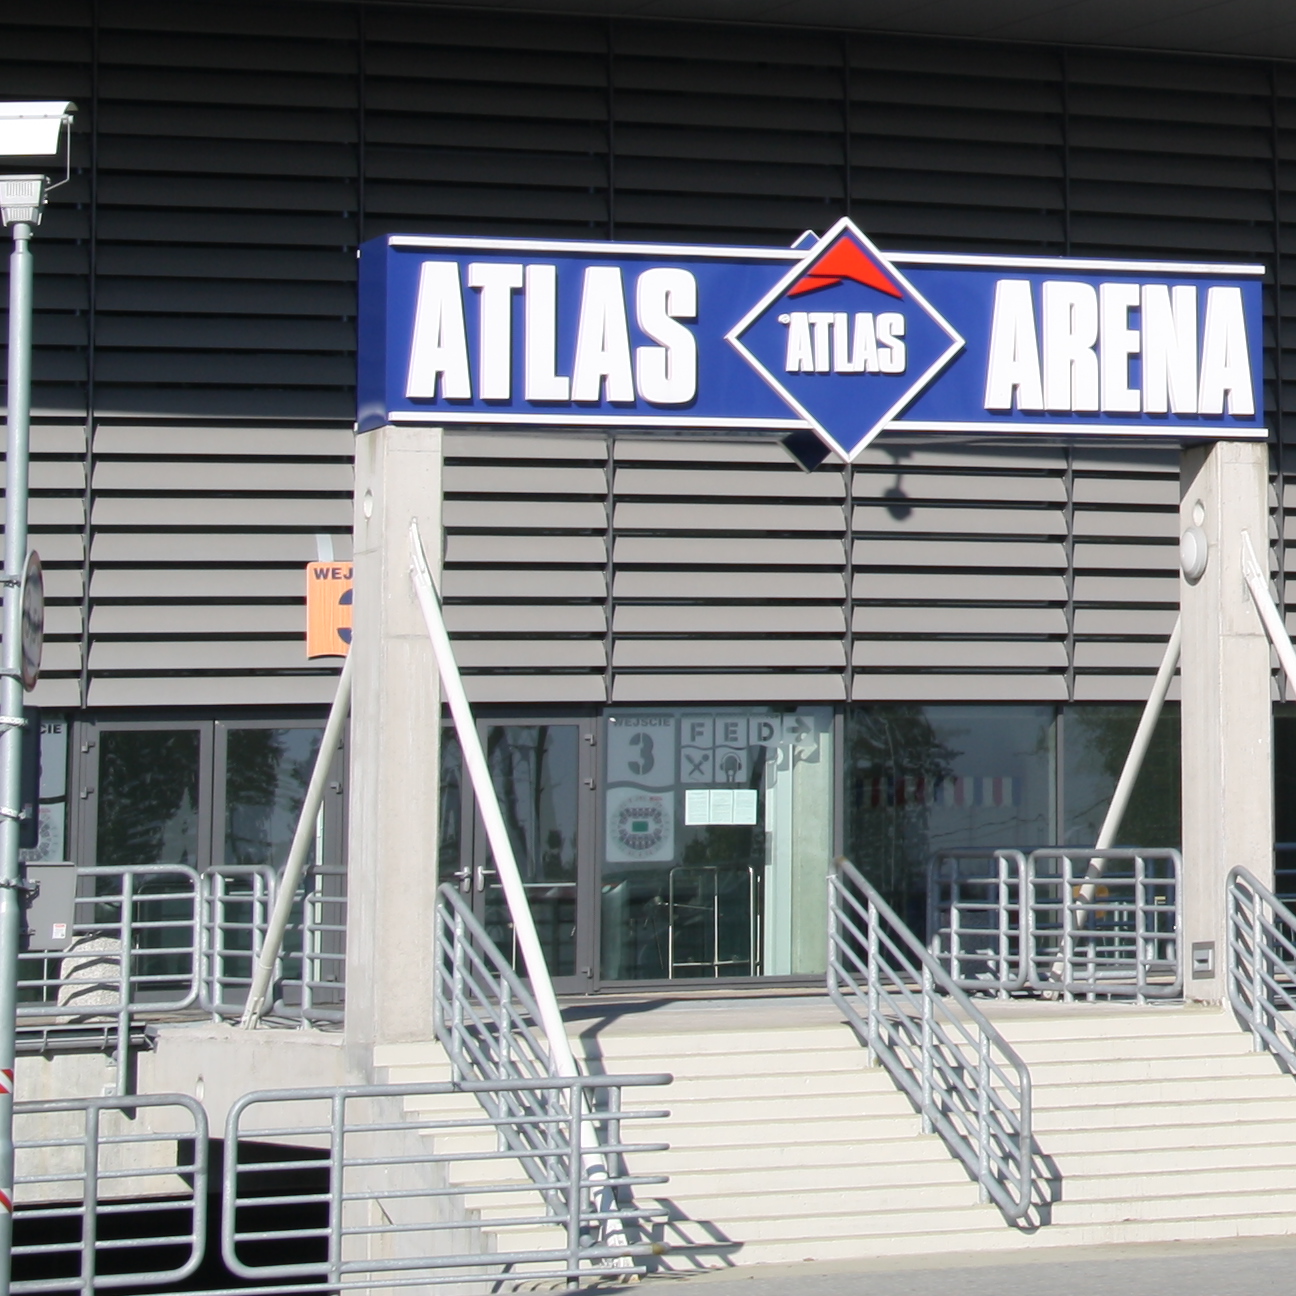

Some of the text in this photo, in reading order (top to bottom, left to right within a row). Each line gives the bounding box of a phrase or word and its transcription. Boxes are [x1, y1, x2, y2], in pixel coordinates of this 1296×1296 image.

[405, 261, 1255, 415] ATLAS ARENA
[786, 311, 906, 374] ATLAS
[627, 732, 655, 776] 3
[690, 722, 775, 742] F E D
